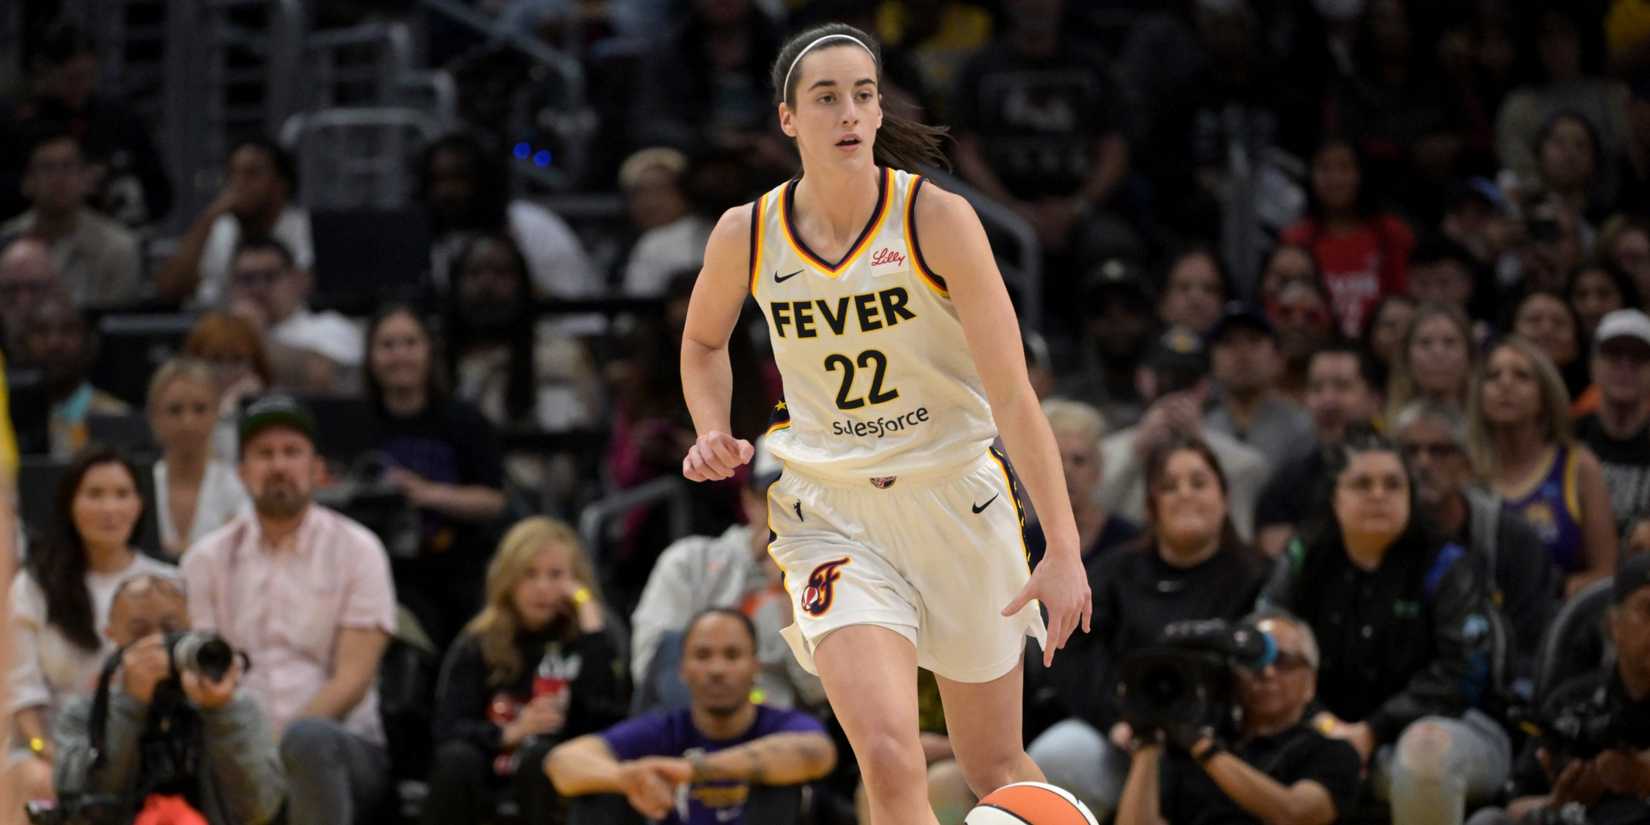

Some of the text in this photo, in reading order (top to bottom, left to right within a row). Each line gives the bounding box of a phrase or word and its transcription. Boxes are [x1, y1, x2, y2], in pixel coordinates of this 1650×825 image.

[872, 248, 905, 266] Lilly
[771, 287, 916, 338] FEVER
[824, 350, 899, 410] 22
